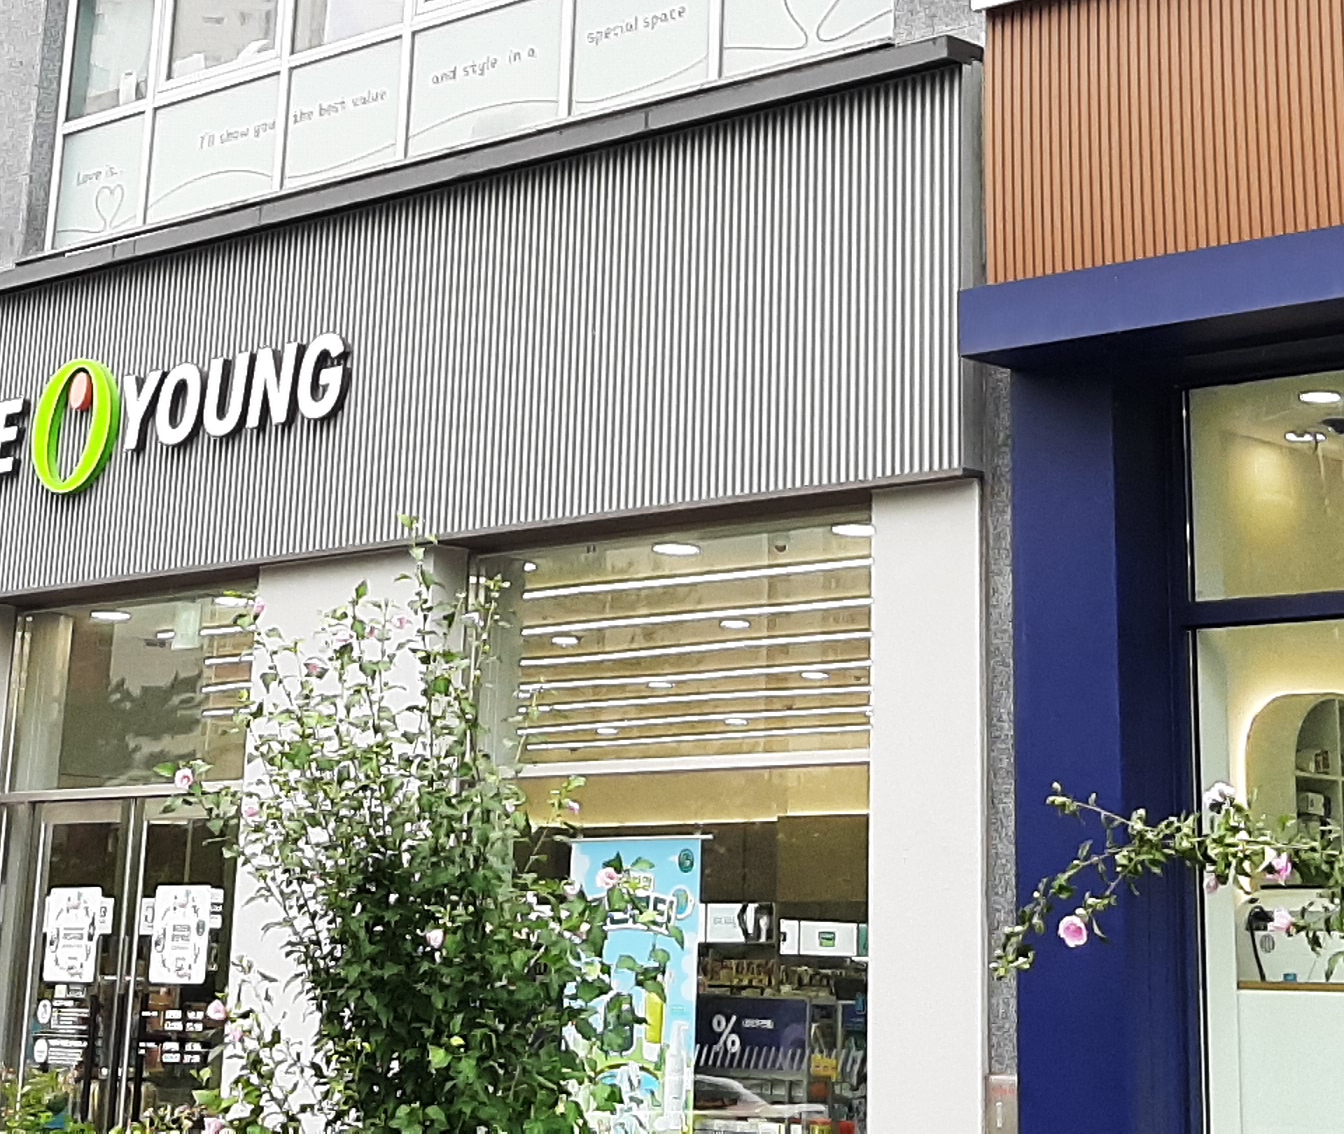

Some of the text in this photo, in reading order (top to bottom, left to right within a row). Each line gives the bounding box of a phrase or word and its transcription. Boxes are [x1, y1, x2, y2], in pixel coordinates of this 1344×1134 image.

[430, 65, 458, 85] and
[462, 55, 499, 78] style
[642, 5, 689, 32] space
[123, 329, 354, 454] YOUNG
